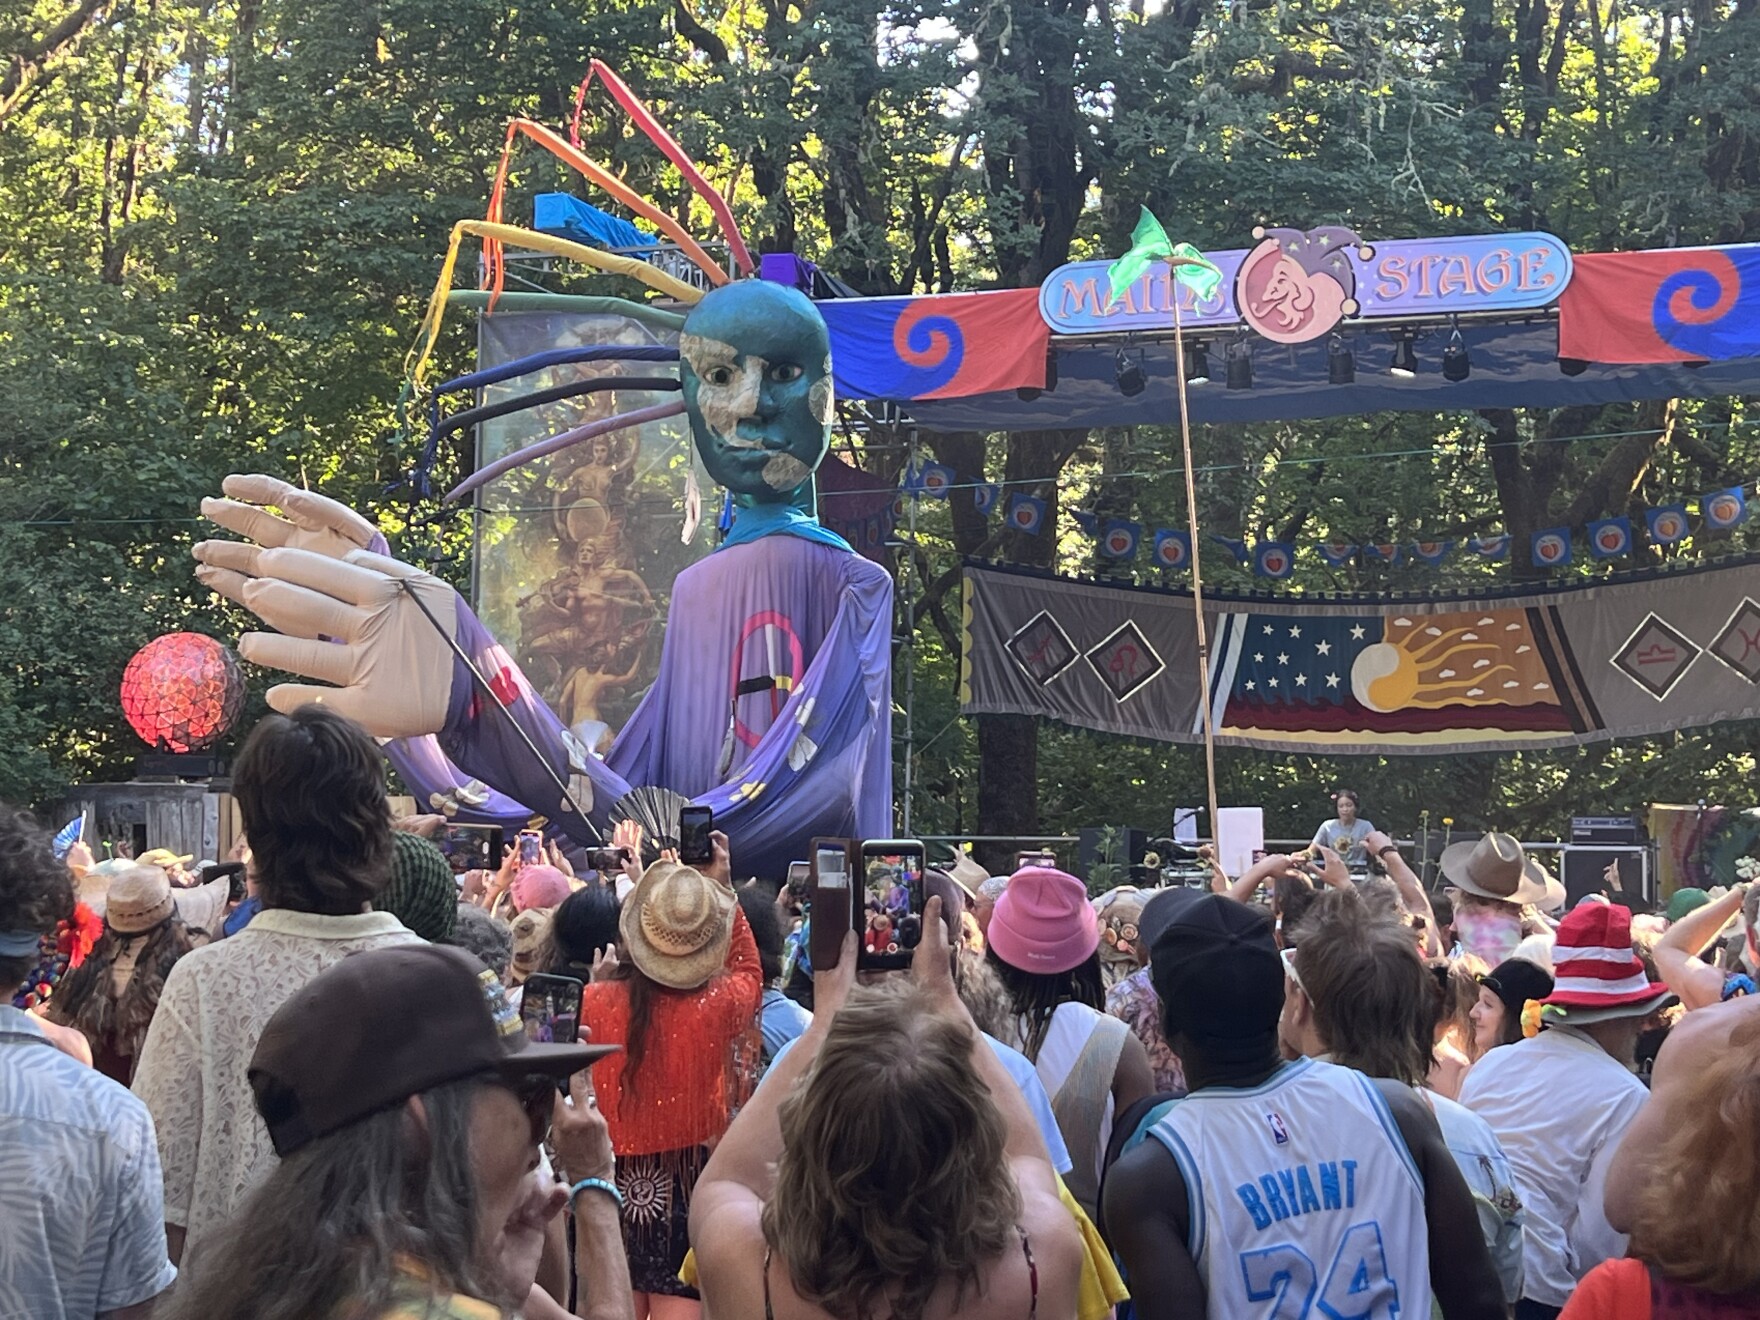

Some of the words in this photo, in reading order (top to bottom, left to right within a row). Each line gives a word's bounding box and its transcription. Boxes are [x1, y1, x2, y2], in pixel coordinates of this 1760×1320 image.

[1374, 247, 1556, 301] STAGE
[1236, 1160, 1358, 1231] BRYANT
[1239, 1221, 1400, 1320] 24
